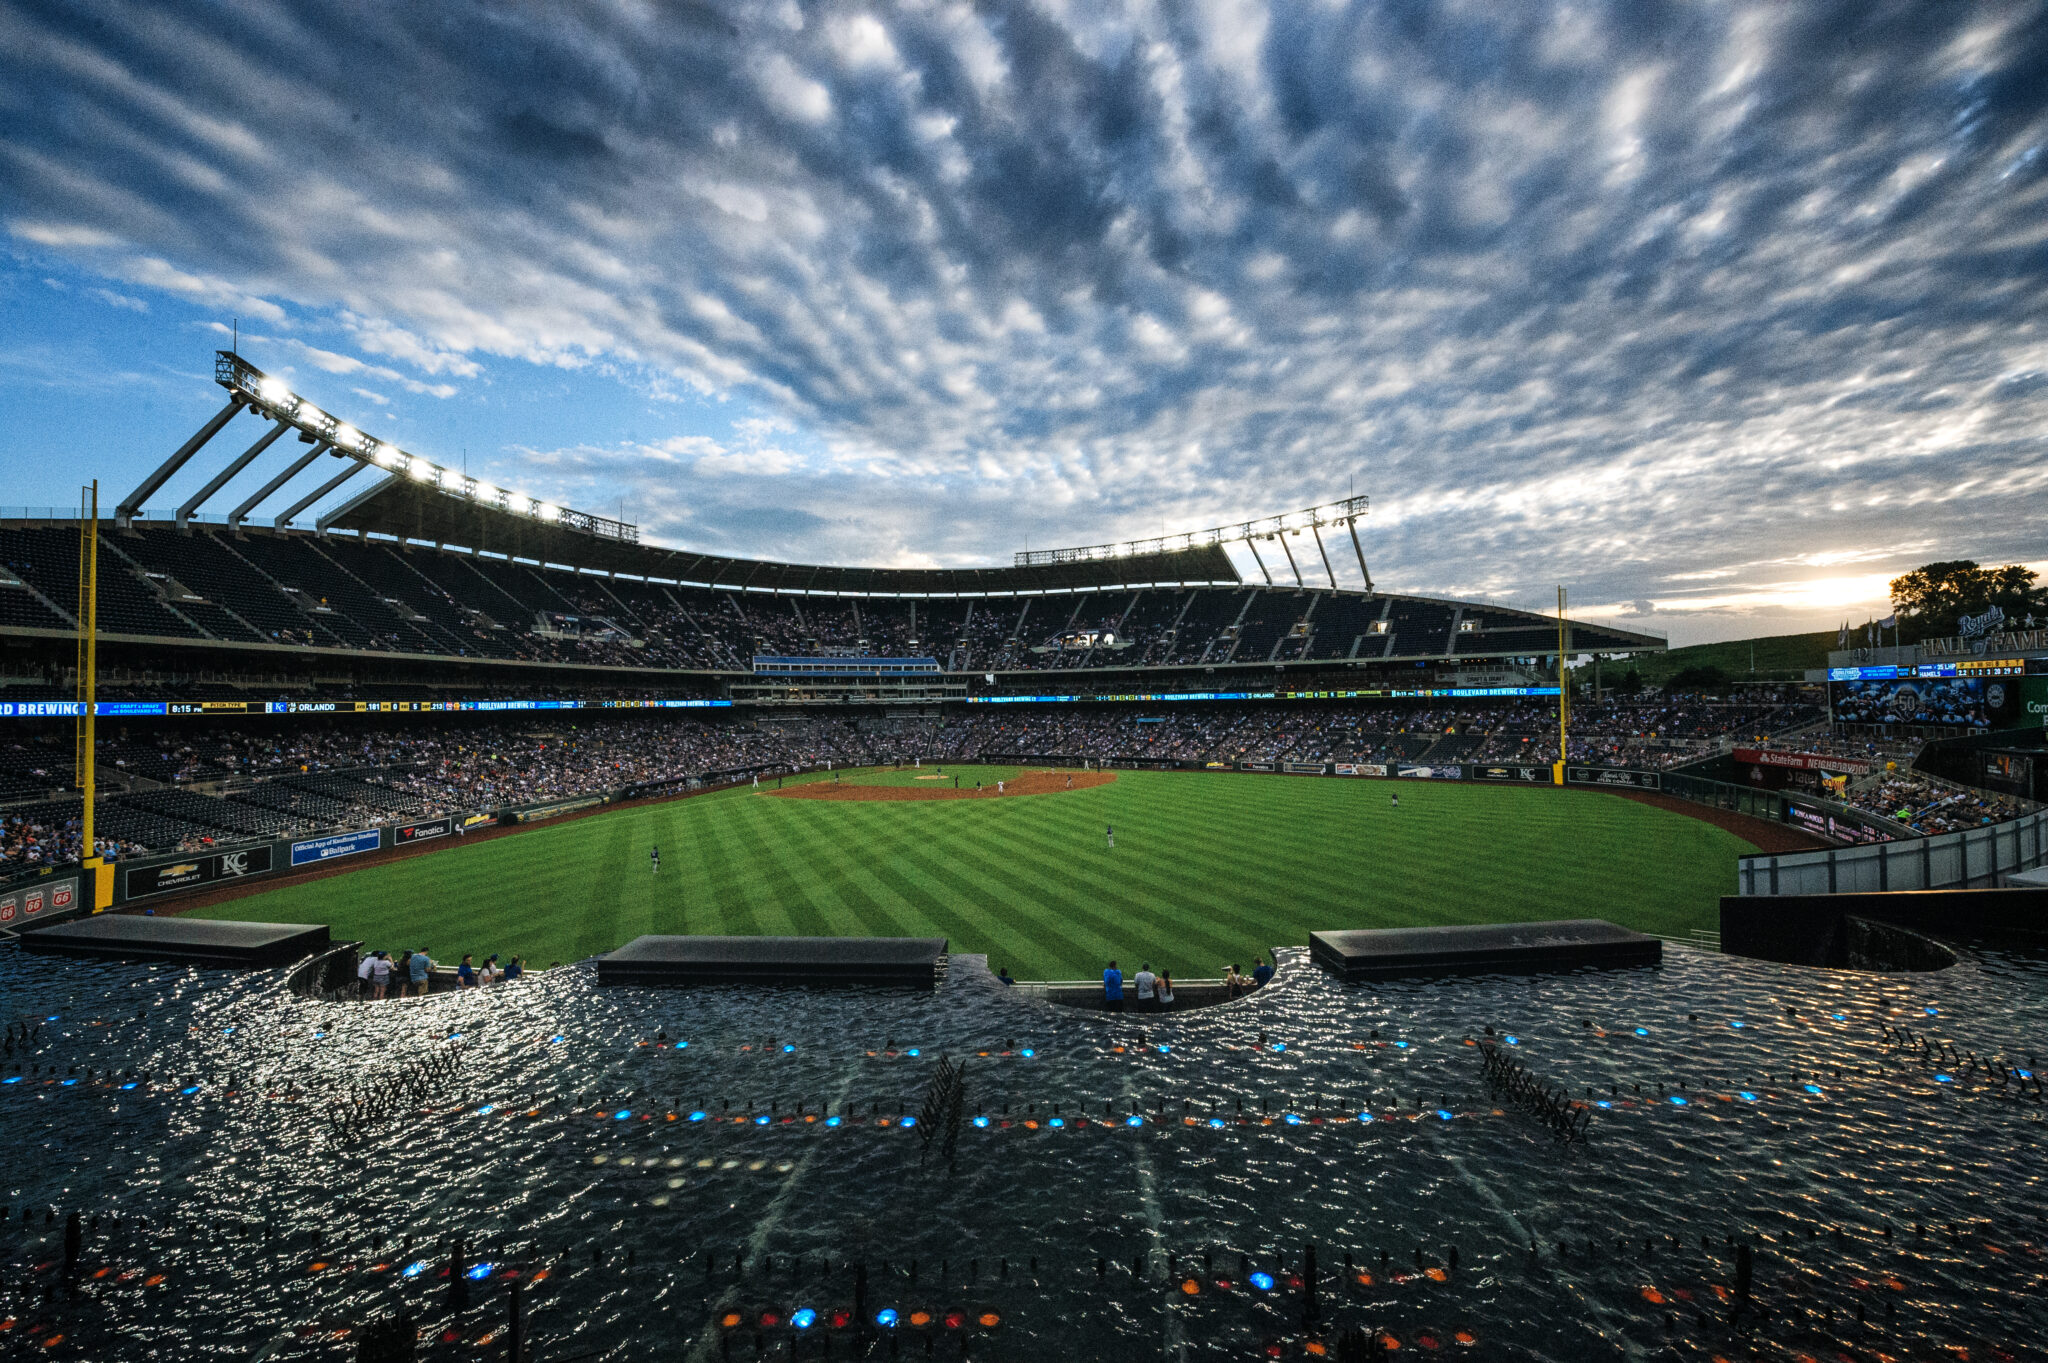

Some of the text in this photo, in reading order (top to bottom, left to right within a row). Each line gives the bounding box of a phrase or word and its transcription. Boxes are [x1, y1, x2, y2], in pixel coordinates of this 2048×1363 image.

[1958, 605, 2005, 635] Royals
[1921, 629, 2048, 657] HALL of FAME
[18, 704, 79, 714] BREWING
[172, 705, 191, 713] 8:15
[276, 702, 284, 711] KC
[1899, 696, 1915, 710] 50
[1520, 768, 1536, 781] KC
[1823, 778, 1845, 792] SONIC
[415, 826, 444, 838] Fanatics
[295, 843, 314, 852] Official
[315, 842, 326, 850] App
[333, 836, 357, 844] Kauffman
[358, 832, 378, 840] Stadium
[329, 844, 356, 855] Ballpark
[222, 852, 248, 876] KC
[158, 874, 200, 887] CHEVROLET
[56, 894, 68, 903] 66
[28, 900, 40, 911] 66
[2, 907, 13, 919] 66
